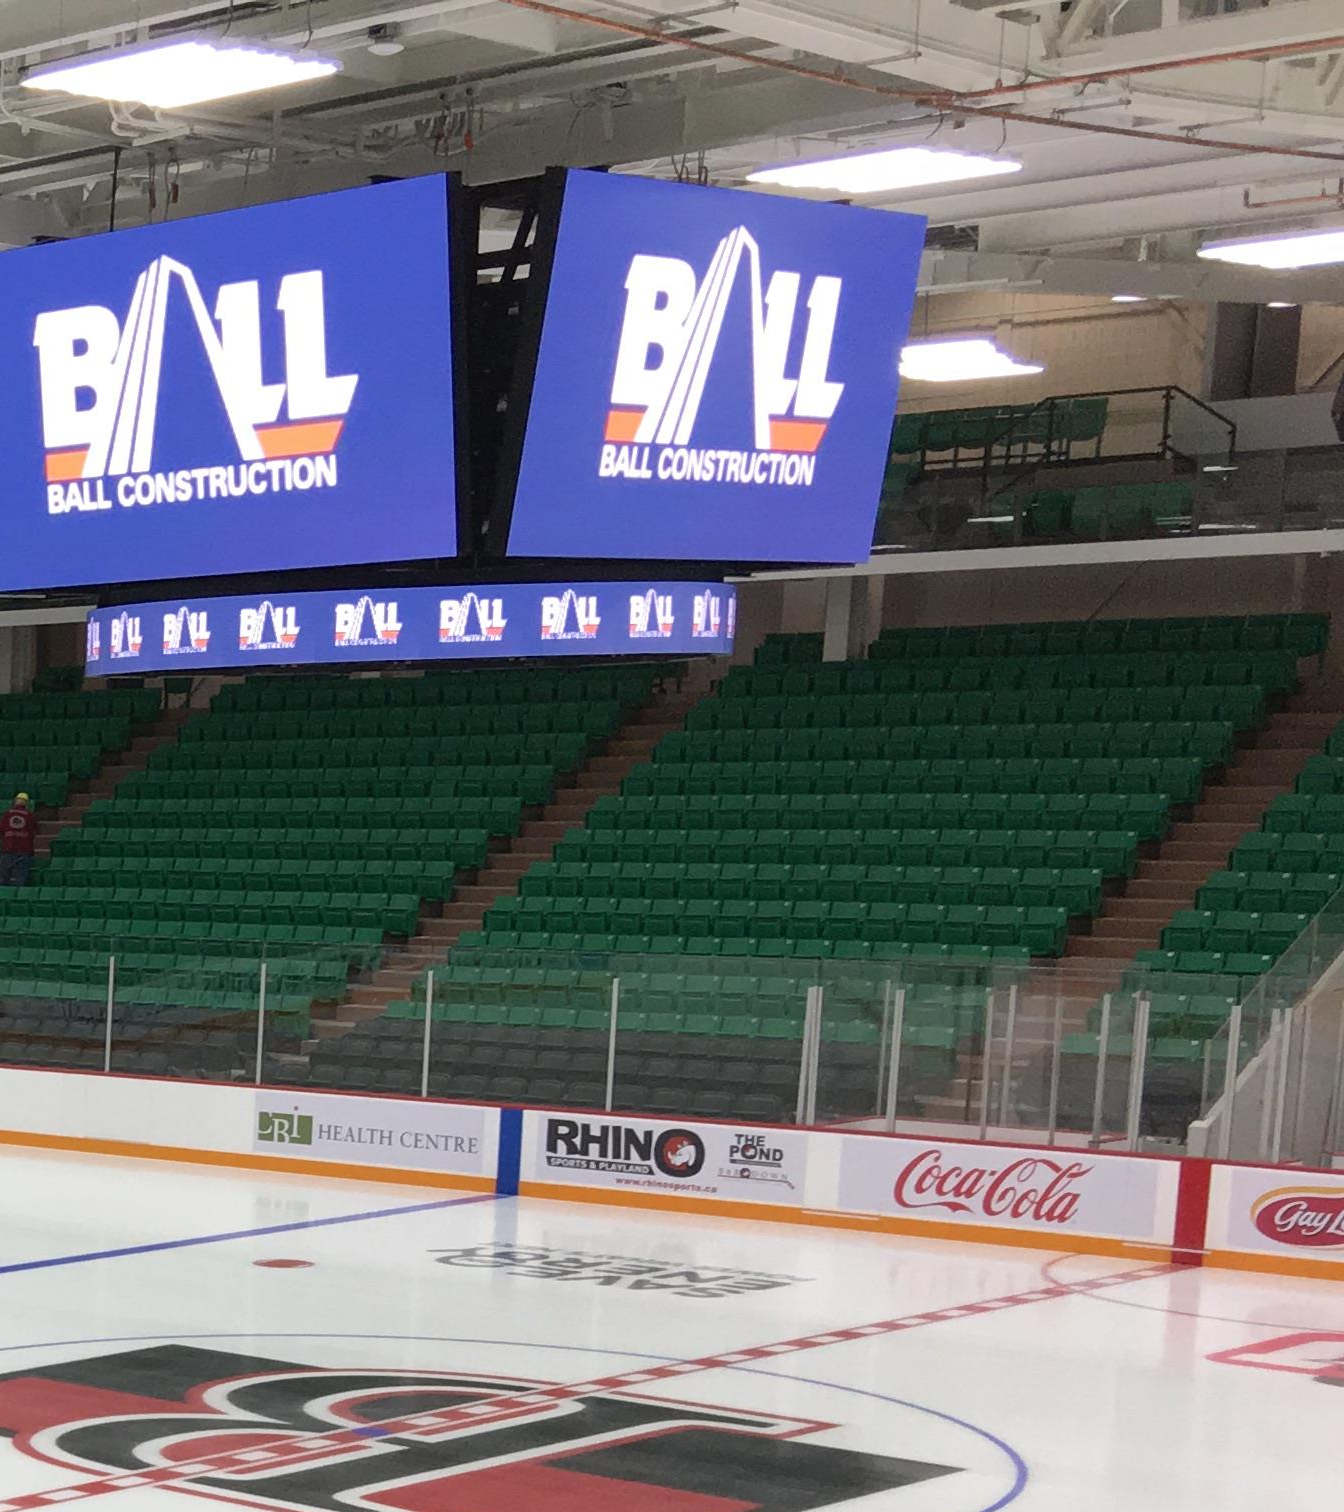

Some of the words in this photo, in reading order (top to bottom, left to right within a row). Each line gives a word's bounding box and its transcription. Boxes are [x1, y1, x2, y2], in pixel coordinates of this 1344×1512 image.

[601, 224, 846, 451] BALL
[32, 254, 360, 480] BALL
[46, 472, 113, 514] BALL
[116, 454, 339, 508] CONSTRUCTION
[598, 443, 654, 479] BALL
[655, 446, 817, 487] CONSTRUCTION
[110, 611, 143, 653] BALL
[162, 606, 211, 649] BALL
[239, 601, 301, 644] BALL
[335, 596, 403, 640] BALL
[439, 592, 509, 637] BALL
[541, 589, 601, 634] BALL
[629, 589, 675, 632] BALL
[692, 589, 720, 632] BALL
[318, 1123, 394, 1147] HEALTH
[399, 1131, 479, 1154] CENTRE
[546, 1118, 706, 1178] RHINO
[729, 1143, 784, 1162] POND
[734, 1133, 766, 1147] THE
[550, 1157, 588, 1169] SPORTS
[589, 1161, 598, 1170] &
[599, 1161, 651, 1175] PLAYLAND
[893, 1149, 1095, 1224] Coca-Cola
[1274, 1200, 1333, 1236] Gay
[507, 1264, 745, 1299] SAVE
